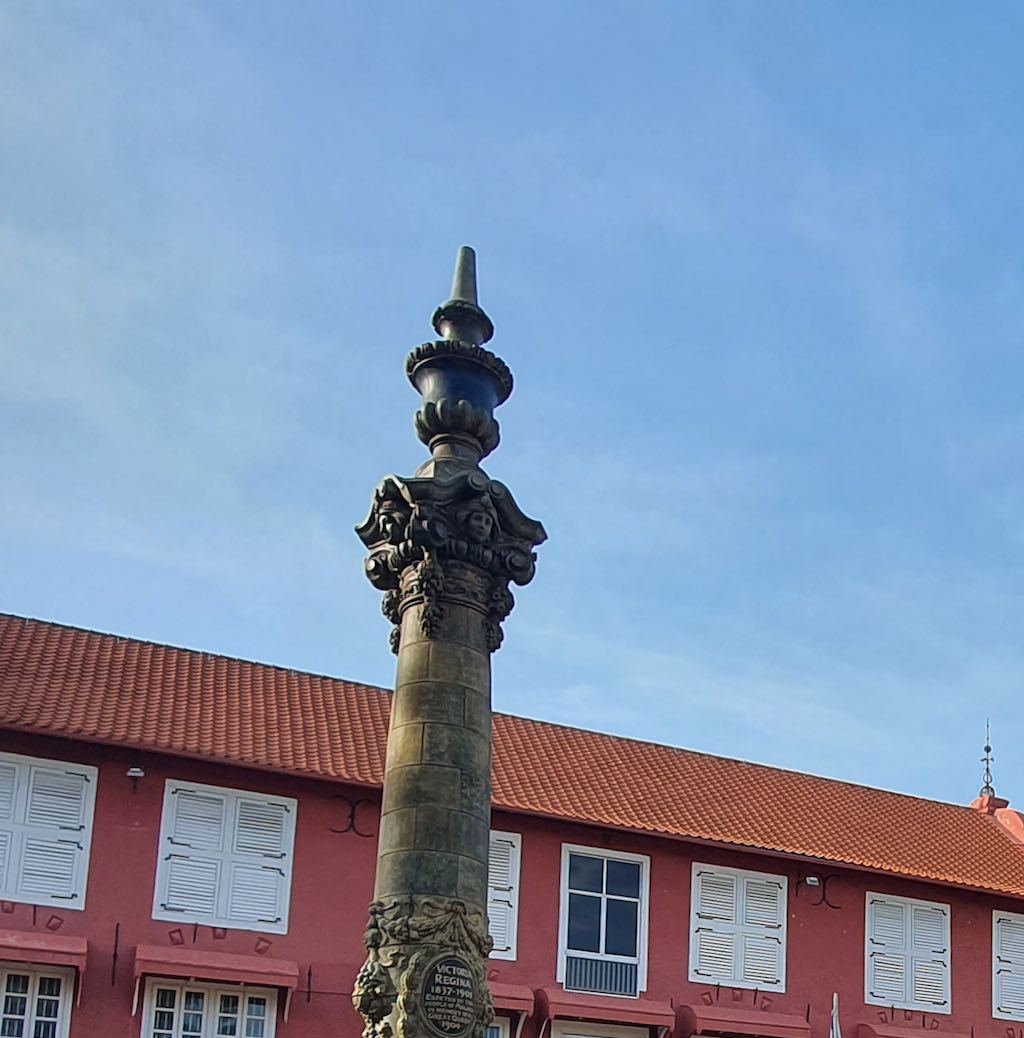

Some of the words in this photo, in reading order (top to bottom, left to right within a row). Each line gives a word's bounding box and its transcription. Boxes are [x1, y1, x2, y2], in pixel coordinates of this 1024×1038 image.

[436, 964, 472, 979] VICTORIA
[435, 973, 471, 988] REGINA
[431, 986, 473, 998] 1837-1901
